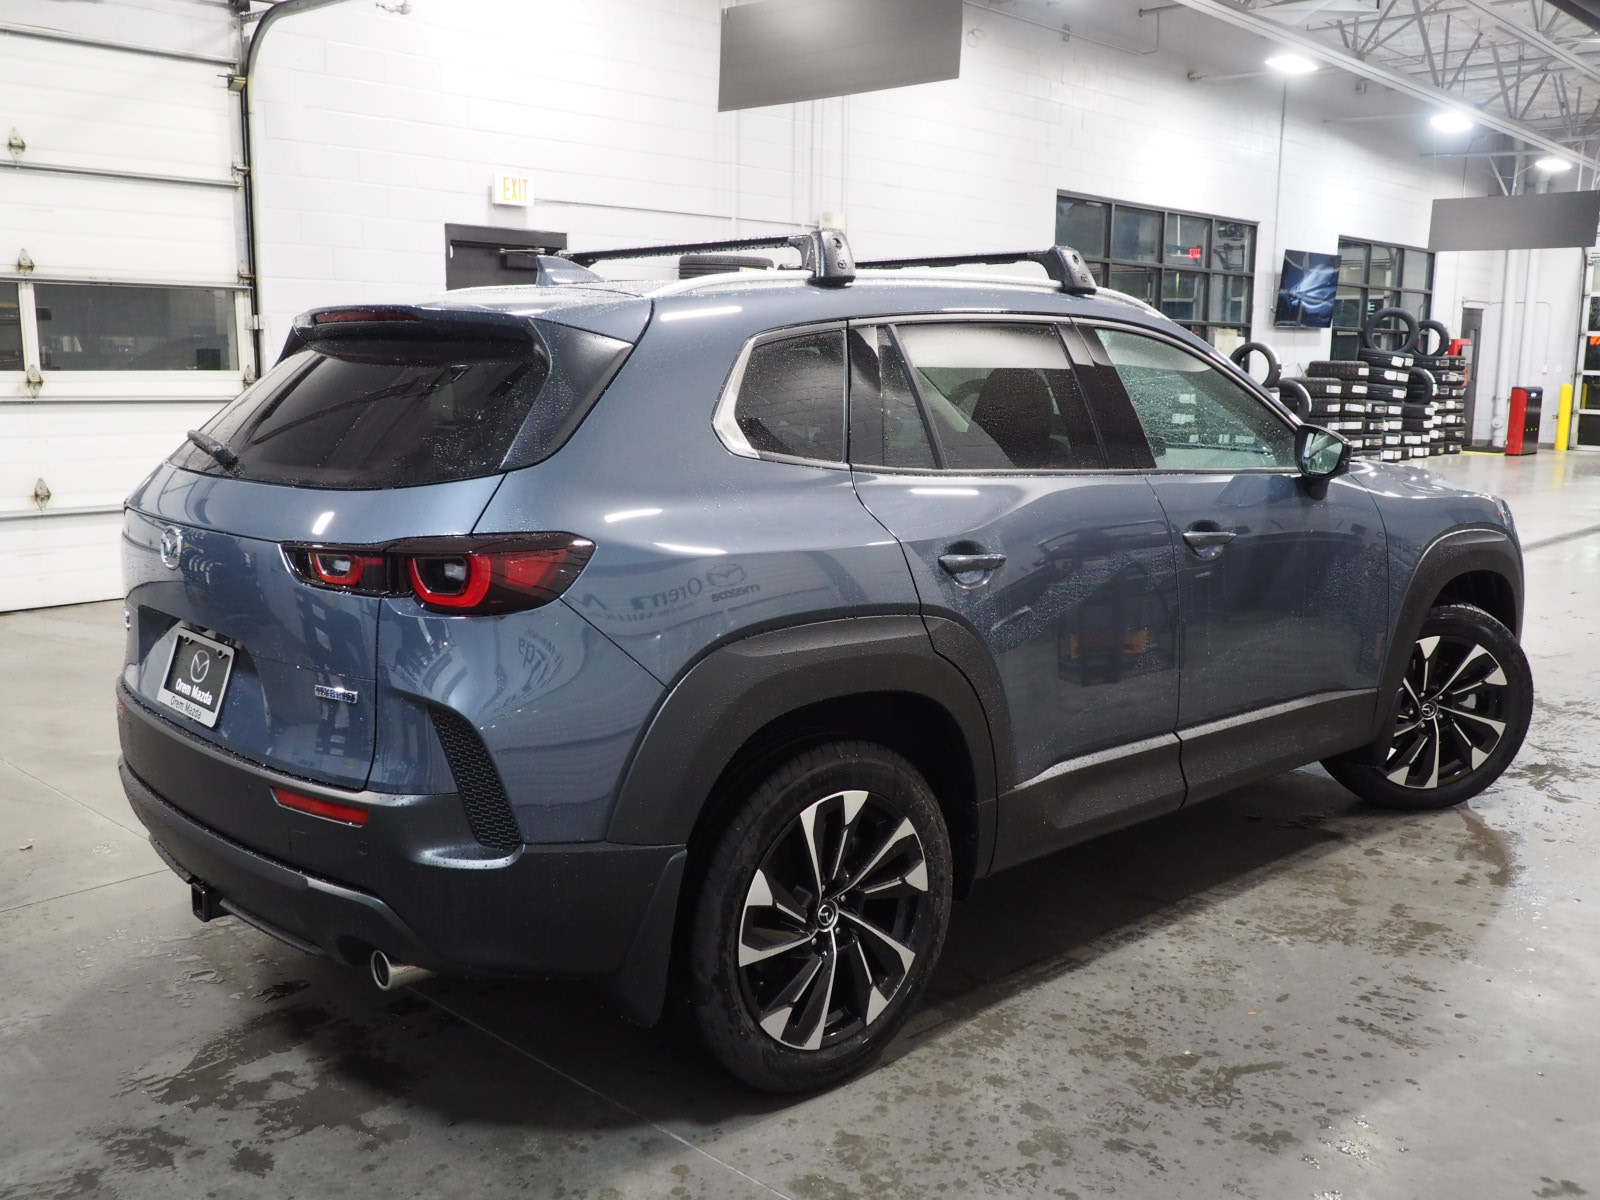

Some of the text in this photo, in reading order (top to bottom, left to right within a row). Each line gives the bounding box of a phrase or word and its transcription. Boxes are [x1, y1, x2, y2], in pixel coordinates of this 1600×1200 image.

[503, 176, 529, 202] EXIT
[175, 677, 213, 705] Orem Mazda
[170, 695, 202, 719] Orem Mazda
